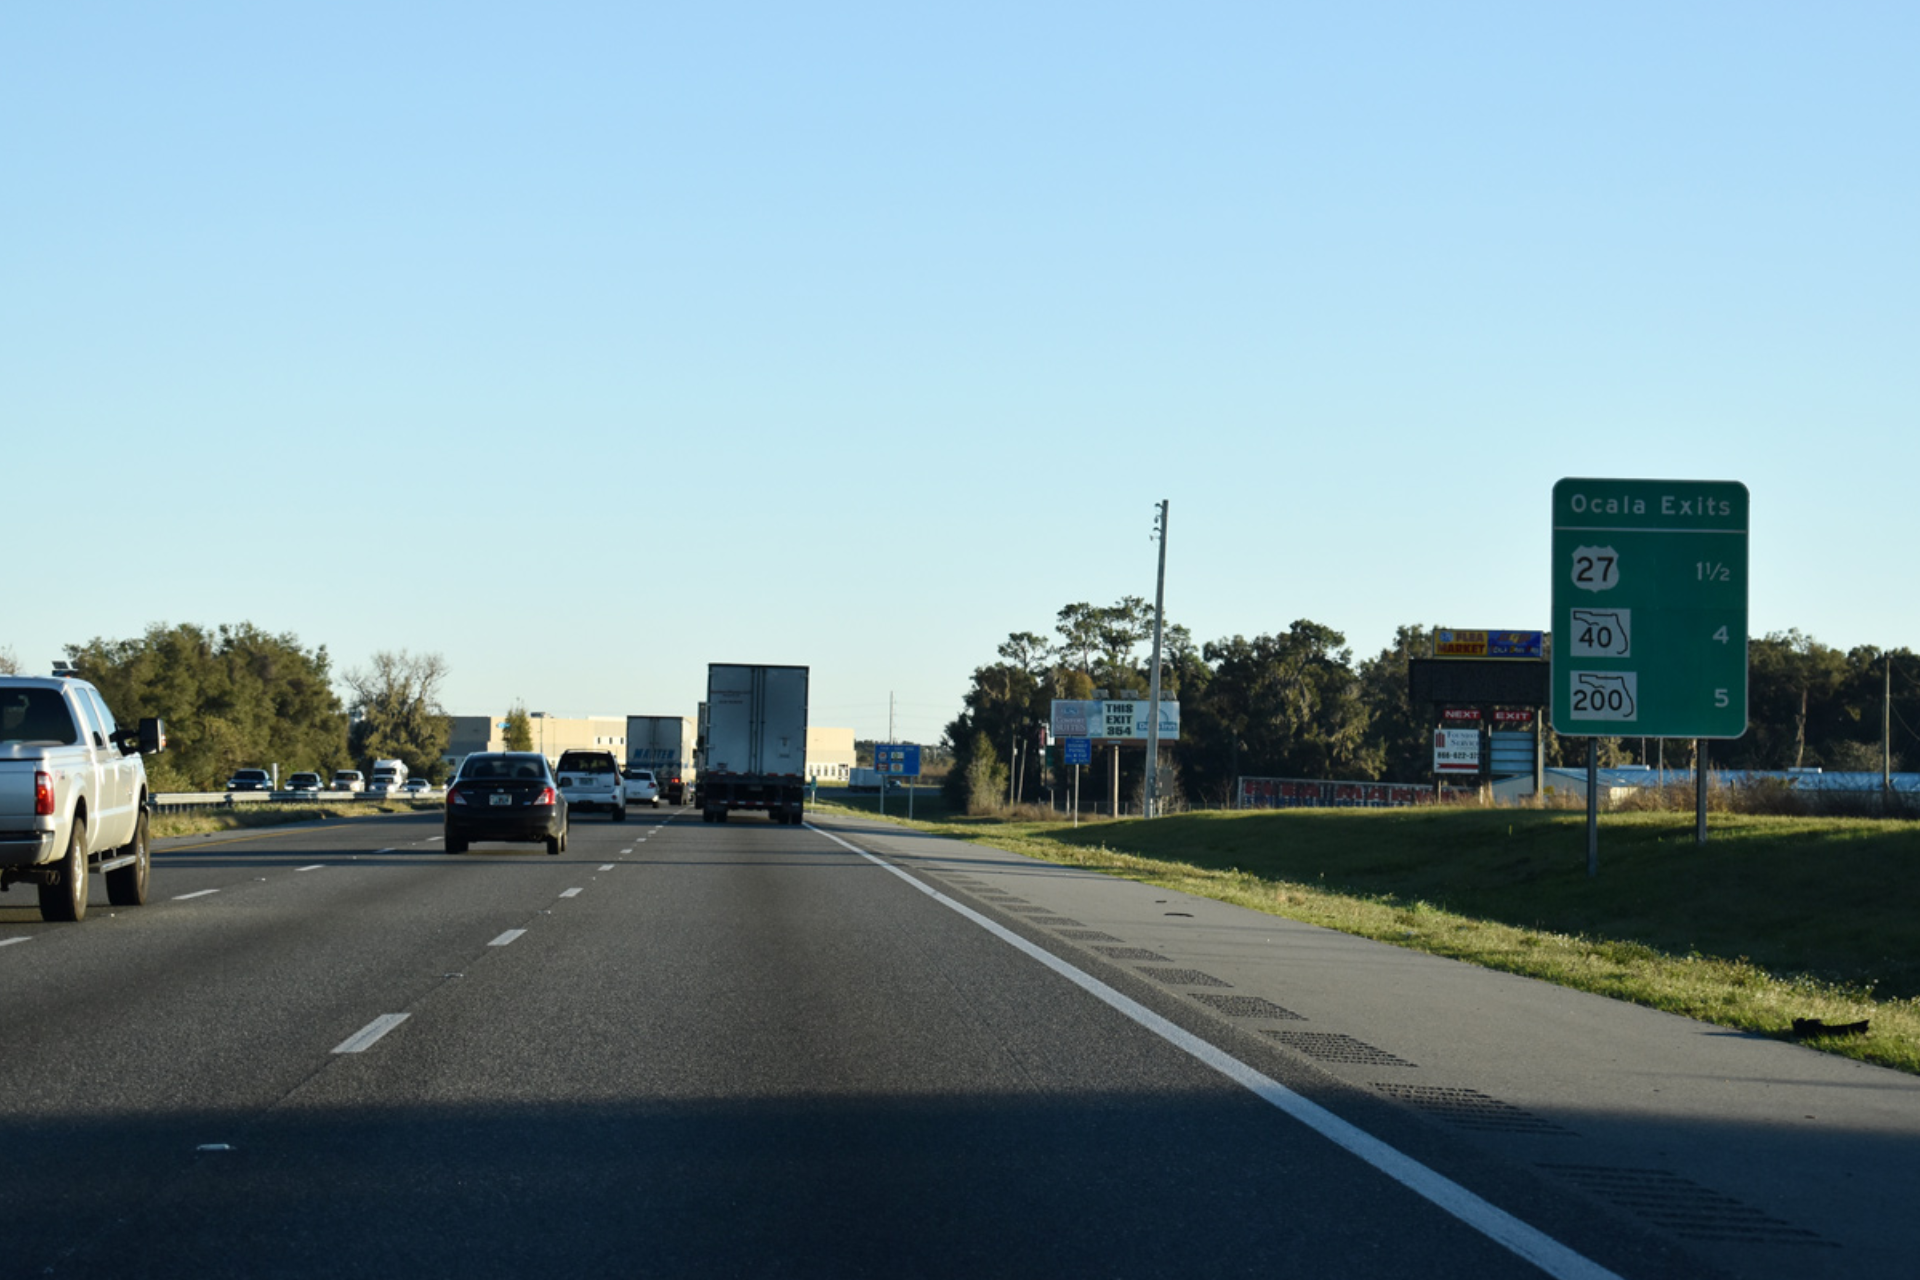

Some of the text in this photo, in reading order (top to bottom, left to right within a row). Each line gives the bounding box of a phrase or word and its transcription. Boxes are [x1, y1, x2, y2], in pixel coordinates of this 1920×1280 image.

[1571, 494, 1731, 516] Ocala Exits
[1576, 556, 1614, 582] 27
[1456, 632, 1484, 642] FLEA
[1579, 626, 1612, 648] 40
[1712, 625, 1730, 645] 4
[1437, 644, 1486, 654] MARKET
[1573, 689, 1623, 711] 200
[1714, 688, 1729, 708] 5
[1105, 704, 1134, 713] THIS
[1445, 711, 1530, 720] NEXT EXIT
[1105, 715, 1133, 724] EXIT
[1107, 726, 1132, 736] 354
